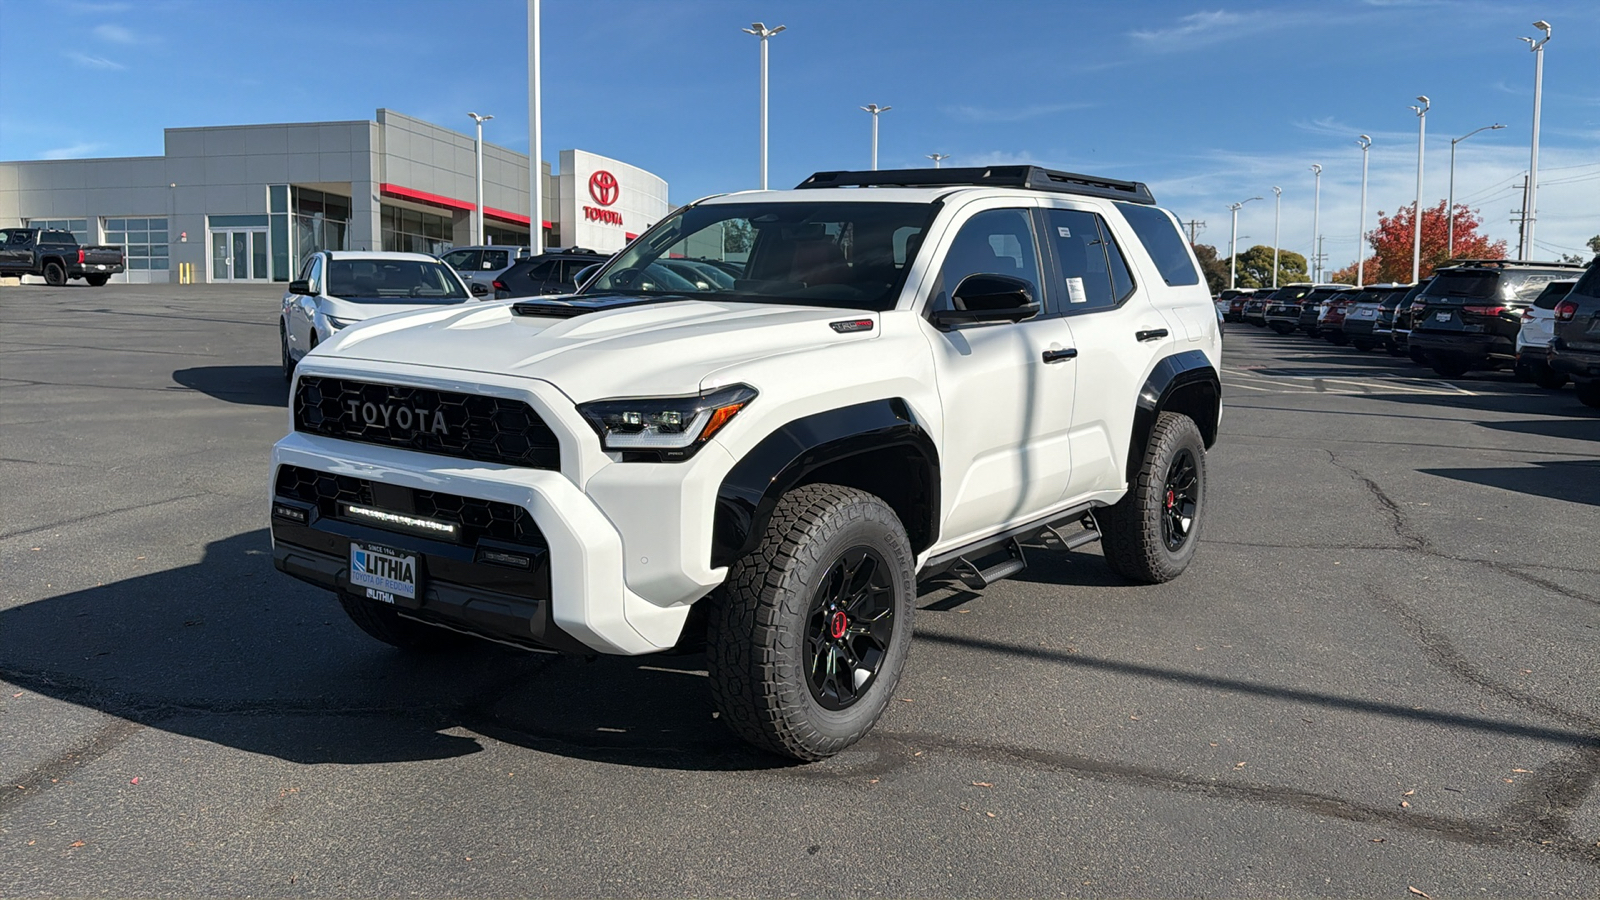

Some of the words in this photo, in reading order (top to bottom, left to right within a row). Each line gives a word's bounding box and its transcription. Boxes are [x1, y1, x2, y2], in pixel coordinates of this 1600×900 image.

[583, 206, 623, 226] TOYOTA
[347, 400, 448, 434] TOYOTA
[368, 544, 383, 552] SINCE
[383, 547, 395, 556] 1946
[366, 554, 413, 584] LITHIA
[352, 571, 374, 583] TOYOTA
[375, 577, 383, 585] OF
[385, 579, 414, 594] REDDING
[373, 589, 395, 604] LITHIA
